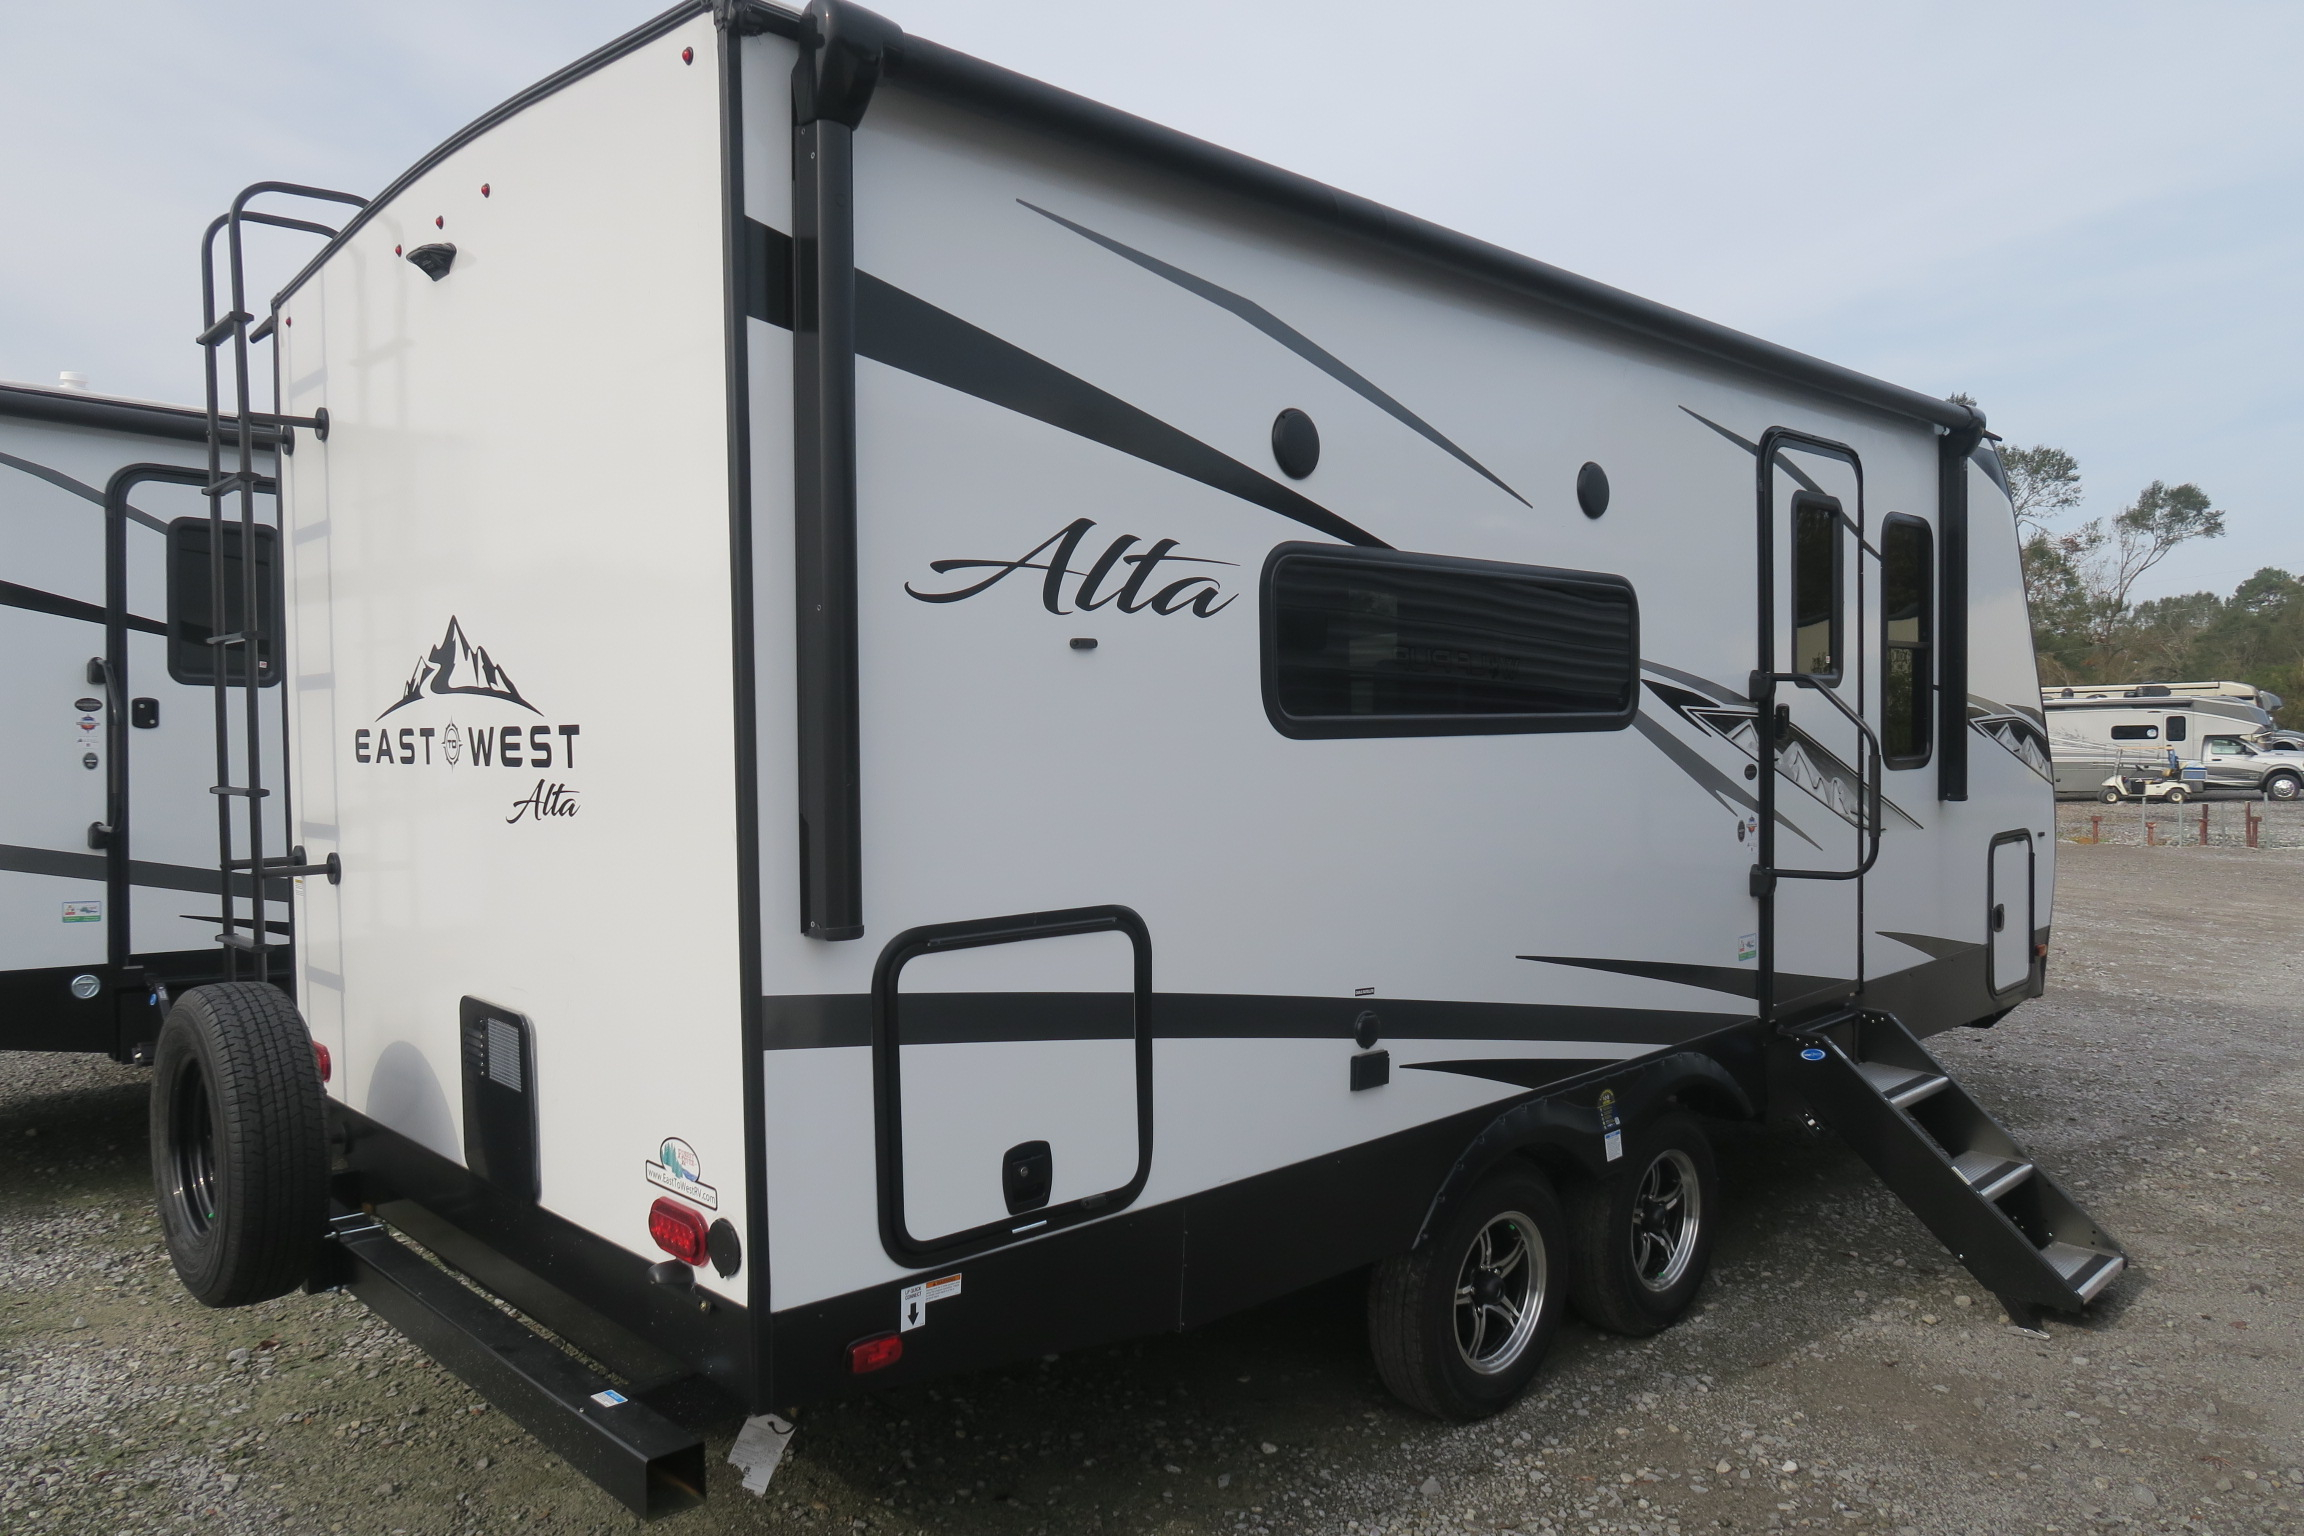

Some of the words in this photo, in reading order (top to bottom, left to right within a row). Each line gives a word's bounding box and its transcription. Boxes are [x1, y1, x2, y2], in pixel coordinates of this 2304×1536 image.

[904, 517, 1241, 619] Alta
[354, 727, 436, 765] EAST
[467, 724, 581, 769] WEST
[505, 778, 581, 825] Alta
[647, 1168, 716, 1204] www.EastToWestRV.com
[904, 1291, 922, 1301] CONNECT
